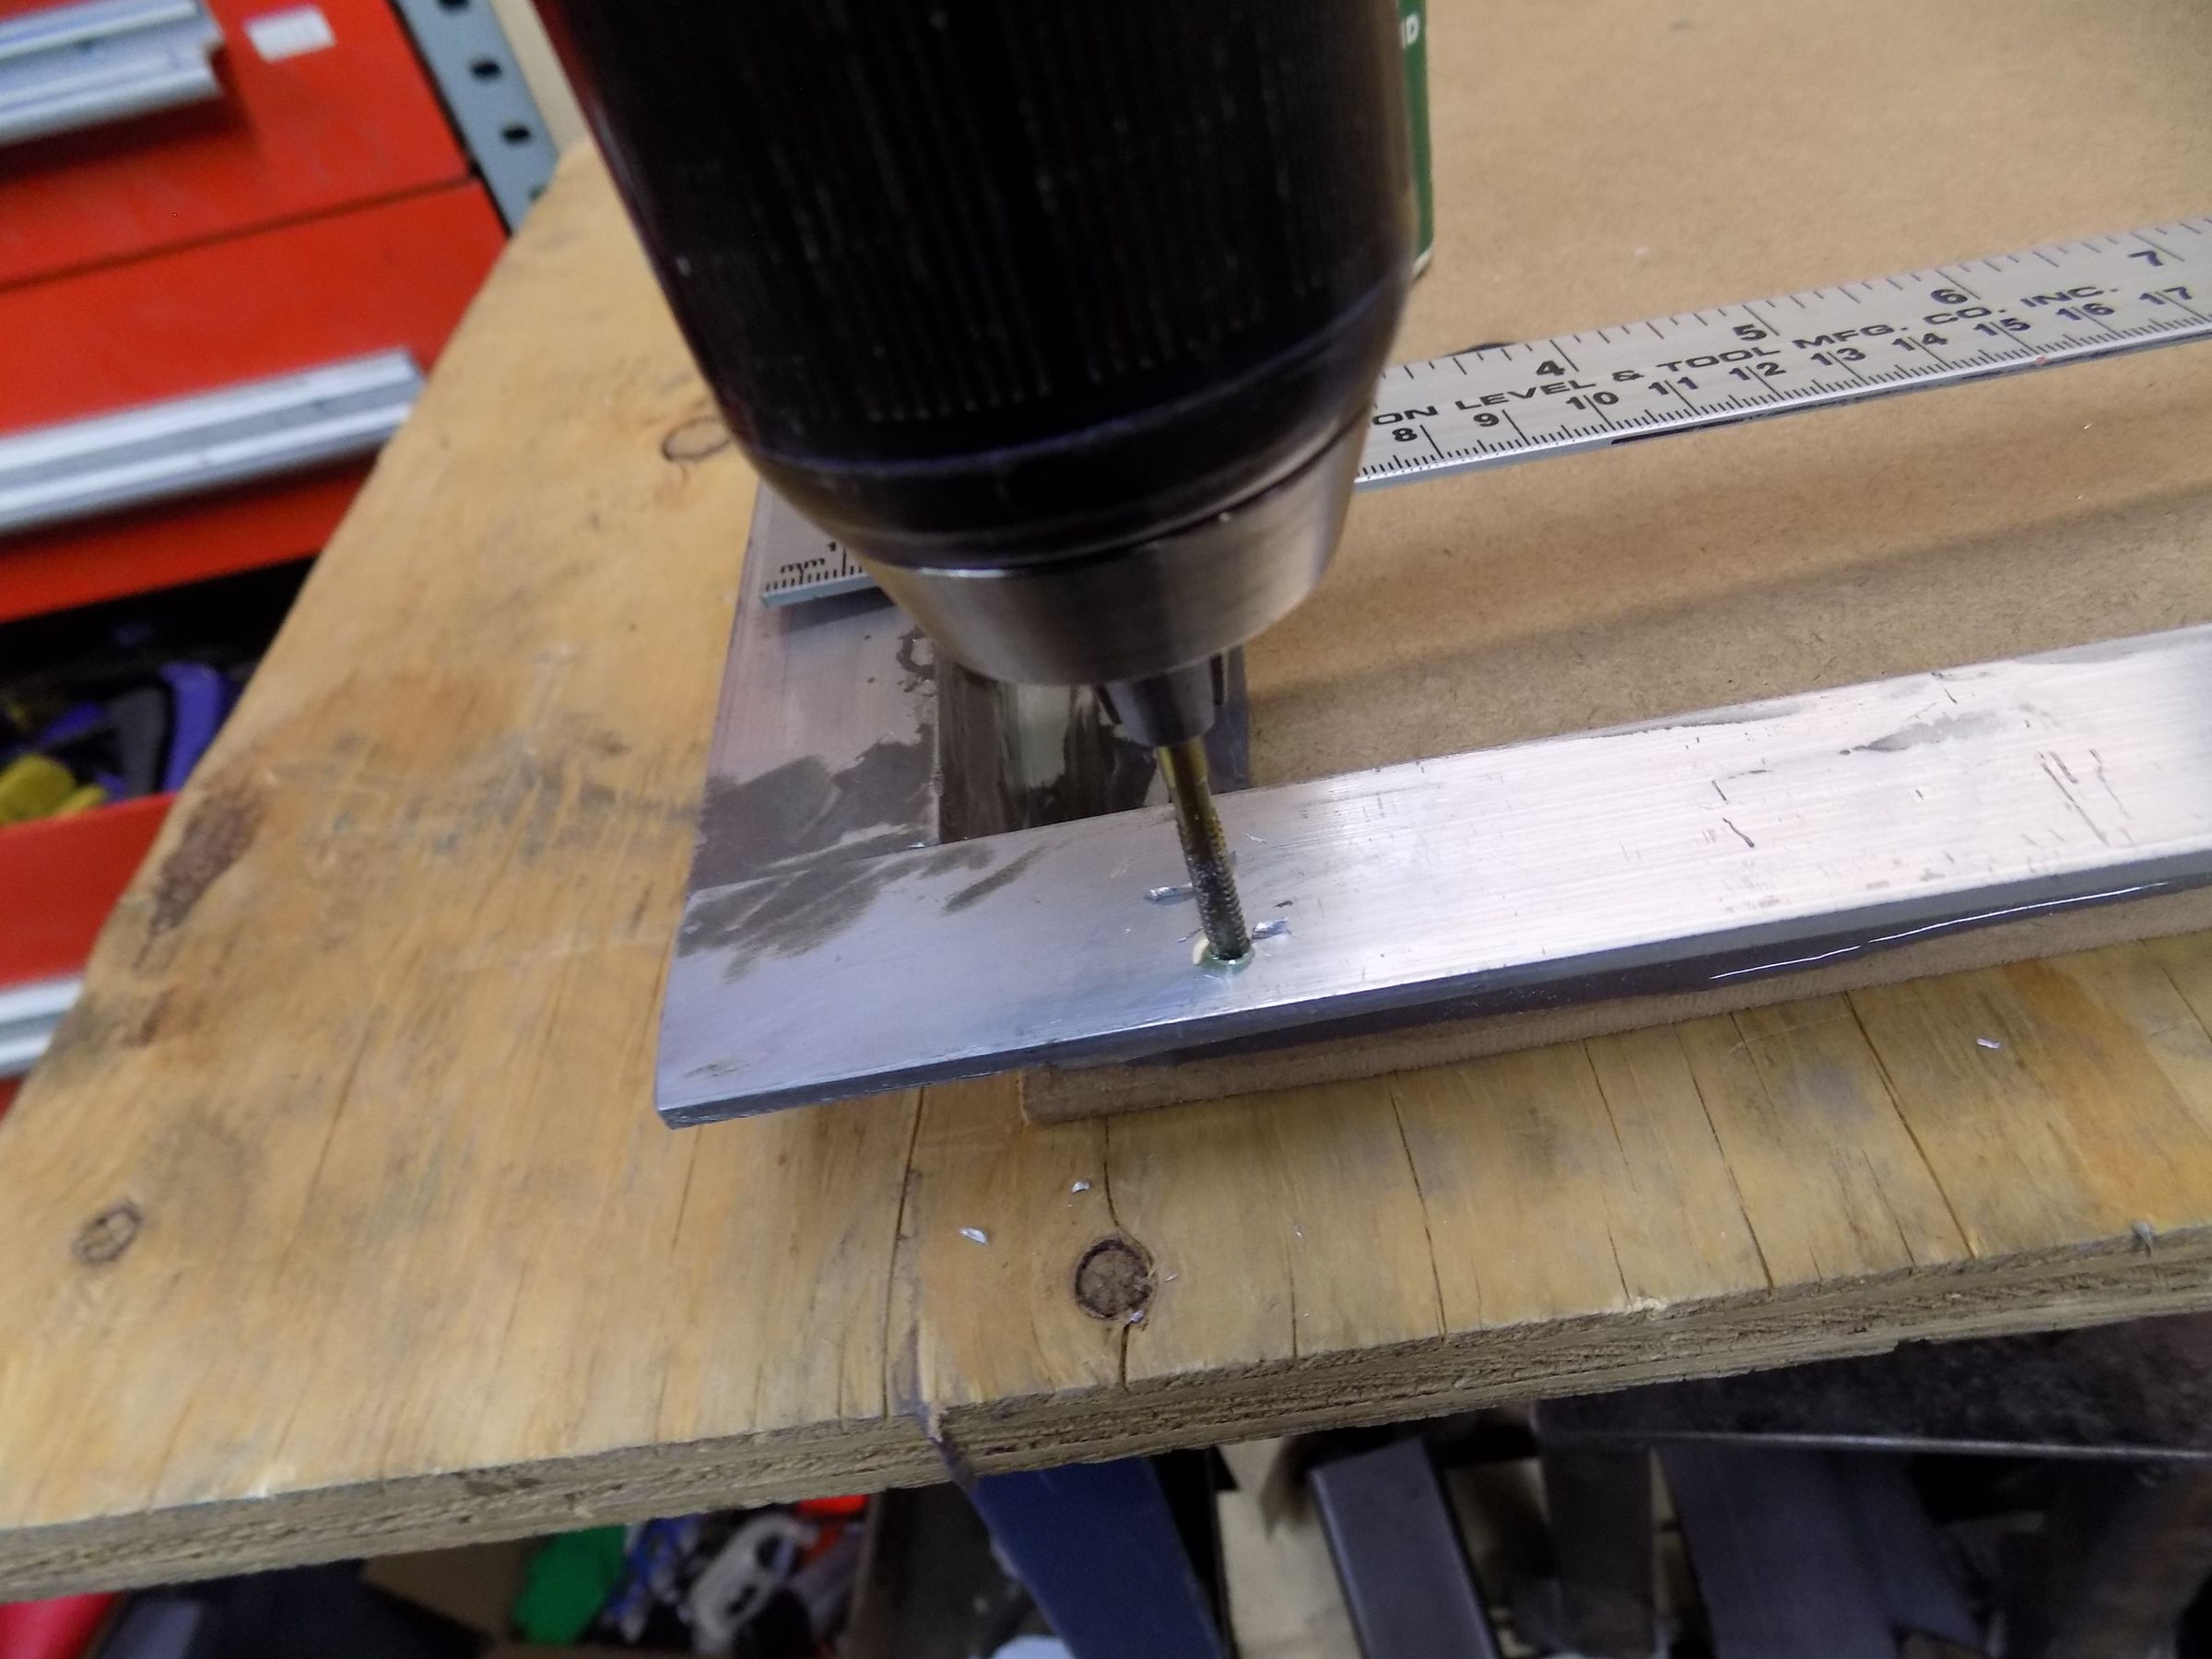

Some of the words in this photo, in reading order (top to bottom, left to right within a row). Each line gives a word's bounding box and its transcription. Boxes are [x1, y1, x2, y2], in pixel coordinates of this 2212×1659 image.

[1394, 427, 1418, 442] 8
[1473, 412, 1500, 428] 9
[1566, 391, 1620, 411] 10
[1648, 376, 1700, 395] 11
[1729, 360, 1786, 381] 12
[1810, 347, 1866, 368] 13
[1892, 332, 1949, 352] 14
[1972, 317, 2031, 337] 15
[2056, 302, 2116, 322] 16
[2139, 286, 2193, 306] 17
[1454, 379, 1596, 411] LEVEL
[1612, 370, 1645, 382] &
[1656, 347, 1781, 372] TOOL
[1792, 324, 1910, 349] MFG.
[1923, 306, 2007, 325] CO.
[2019, 286, 2119, 309] INC.
[1535, 359, 1566, 377] 4
[1735, 324, 1768, 341] 5
[1930, 288, 1969, 306] 6
[2127, 250, 2164, 268] 7
[781, 557, 826, 573] mm
